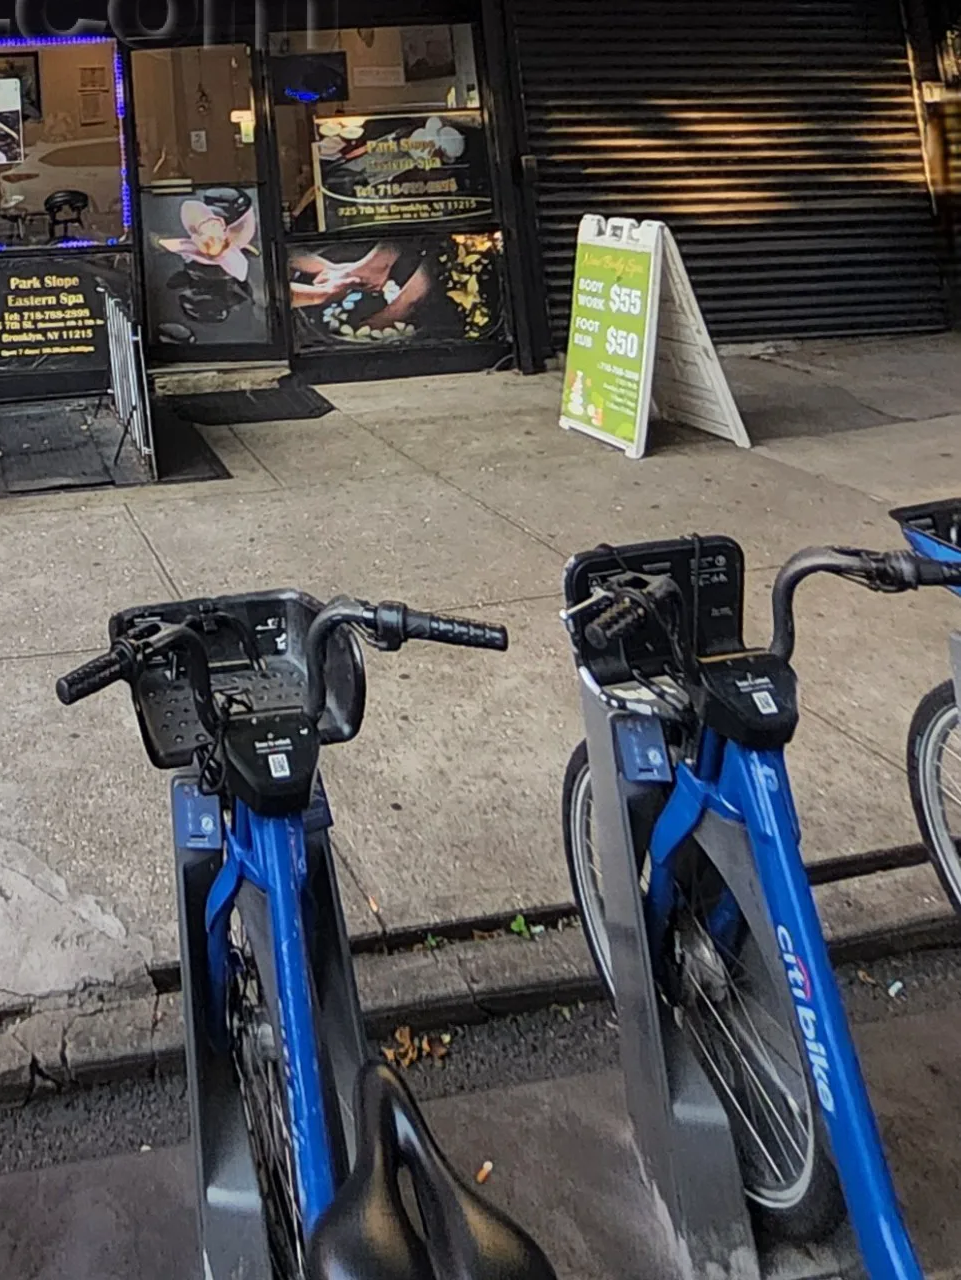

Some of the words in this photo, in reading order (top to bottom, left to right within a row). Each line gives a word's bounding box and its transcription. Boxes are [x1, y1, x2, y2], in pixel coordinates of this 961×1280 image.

[447, 199, 477, 210] 11215
[10, 276, 41, 290] Park
[44, 275, 79, 289] Slope
[579, 277, 605, 294] BODY
[7, 294, 57, 307] Eastern
[59, 292, 85, 306] Spa
[577, 293, 606, 311] WORK
[609, 283, 641, 316] $55
[575, 316, 600, 333] FOOT
[47, 331, 60, 340] NY
[62, 329, 93, 339] 11215
[605, 324, 638, 358] $50
[777, 923, 807, 1002] citi
[796, 1004, 836, 1116] bike
